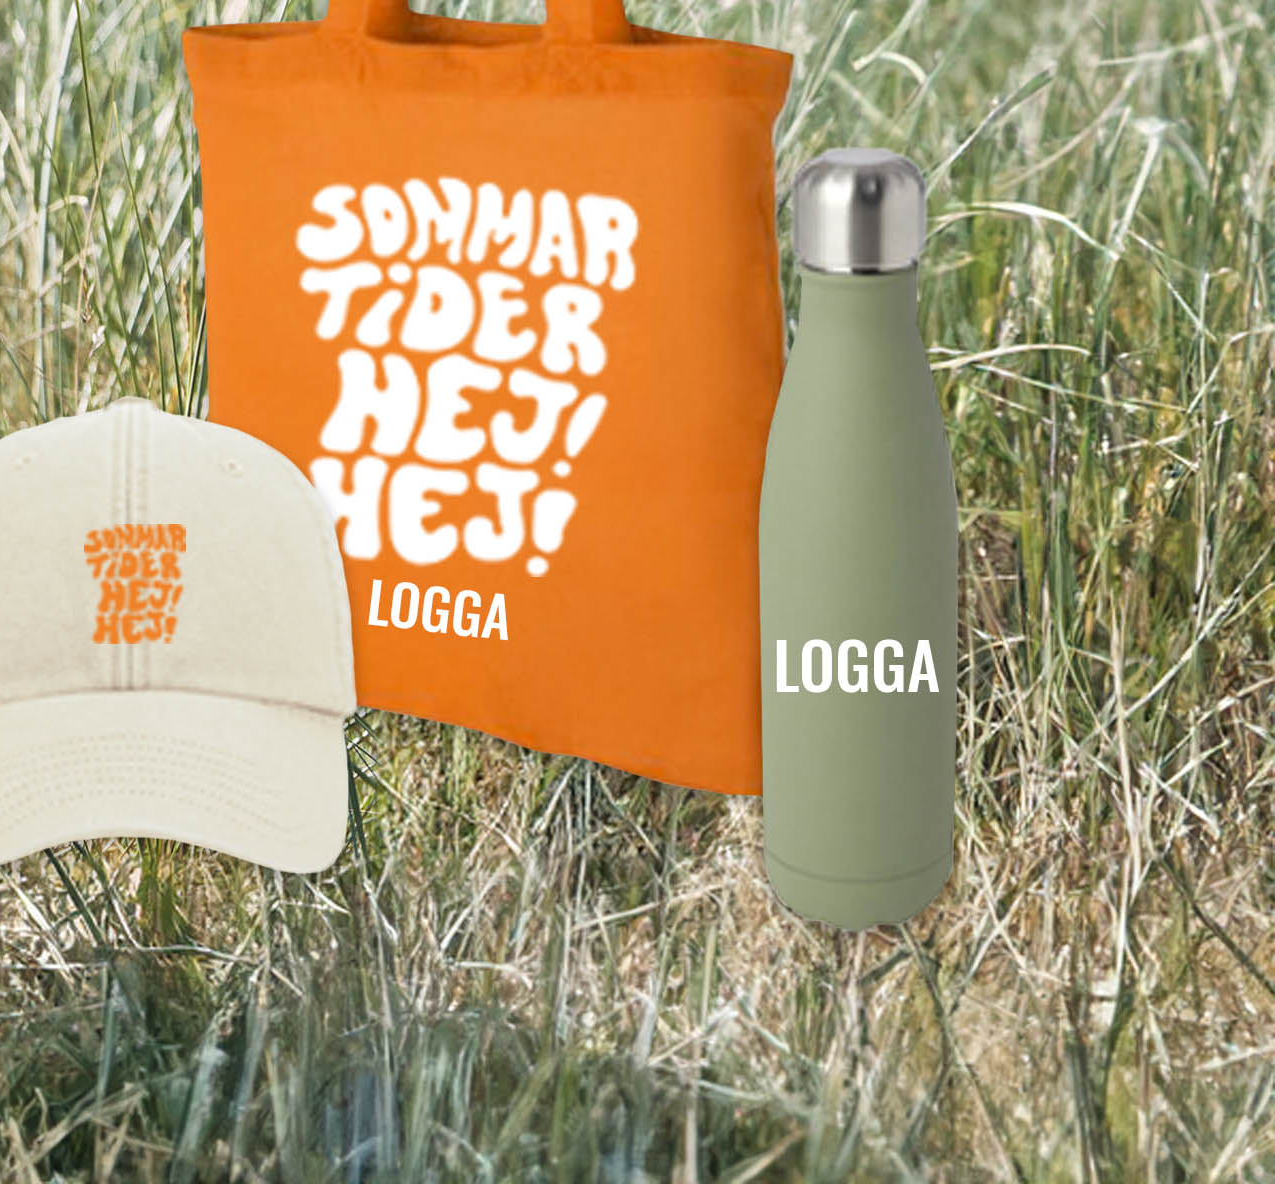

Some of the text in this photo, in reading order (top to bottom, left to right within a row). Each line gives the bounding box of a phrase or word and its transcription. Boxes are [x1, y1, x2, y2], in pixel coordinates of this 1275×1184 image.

[319, 348, 608, 478] HEJ!
[309, 455, 577, 578] HEJ!
[96, 578, 184, 614] HEJ!
[368, 579, 509, 641] LOGGA
[92, 611, 178, 645] HEJ!
[776, 639, 941, 694] LOGGA
